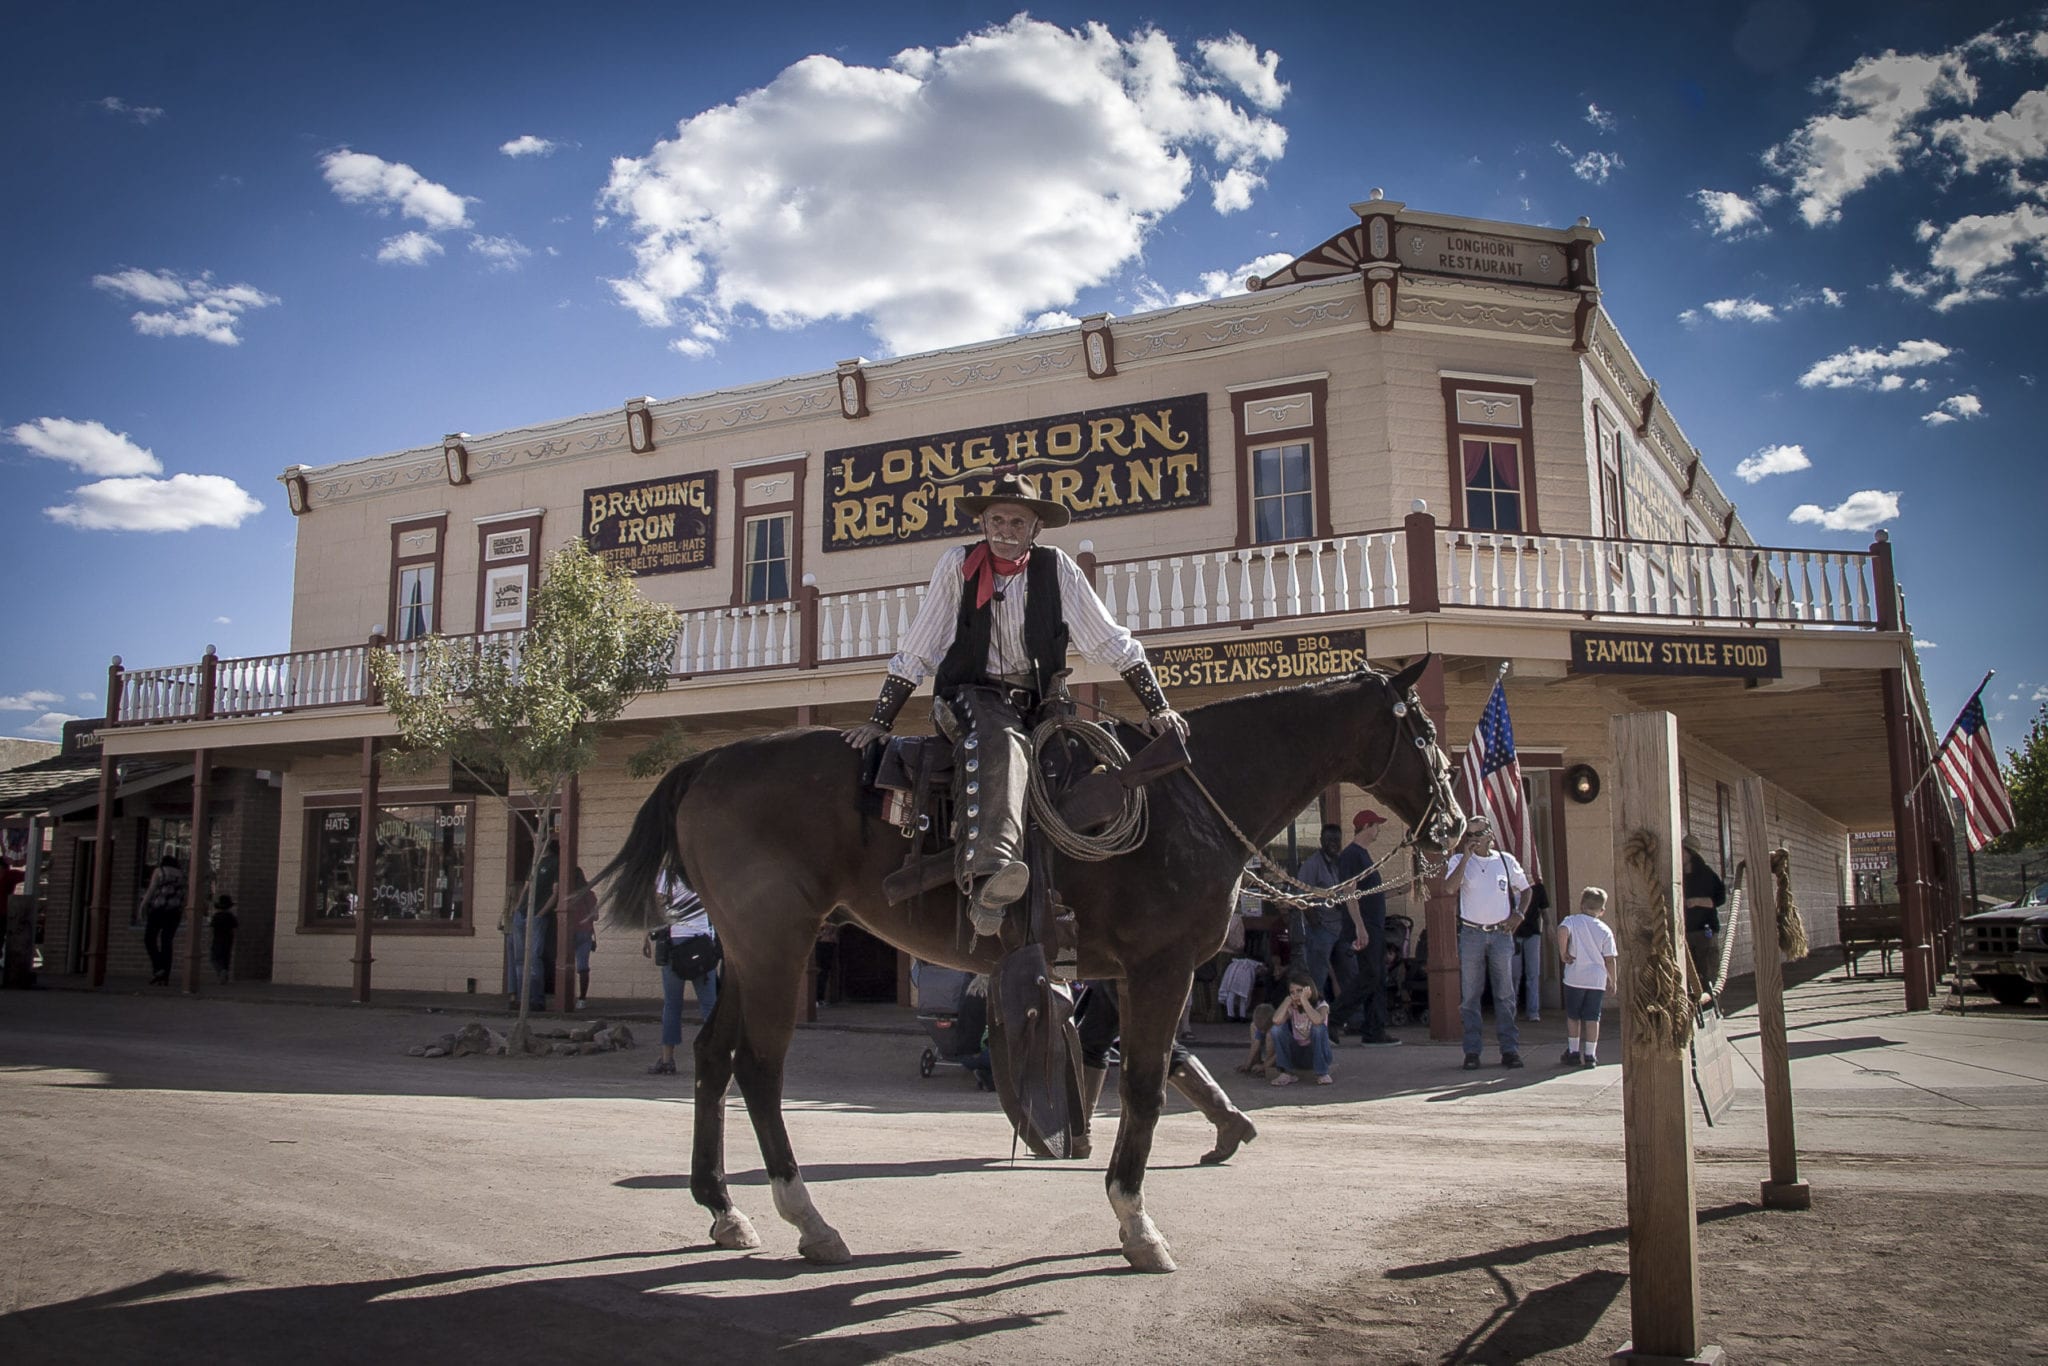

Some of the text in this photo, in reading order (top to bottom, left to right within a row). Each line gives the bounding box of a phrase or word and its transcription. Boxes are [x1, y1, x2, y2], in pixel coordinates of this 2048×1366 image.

[1447, 236, 1515, 258] LONGHORN
[1439, 253, 1524, 277] RESTAURANT
[834, 409, 1189, 496] LONGHORN
[588, 479, 712, 535] BRANDING
[832, 453, 1198, 539] RESTRANT
[618, 513, 677, 545] IRON
[640, 541, 678, 556] APPAREL
[682, 538, 706, 550] HATS
[663, 550, 705, 566] BUCKLES
[496, 597, 518, 608] OFFICE
[1163, 635, 1333, 663] AWARD WINNING BBQ
[1585, 639, 1768, 667] FAMILY STYLE FOOD
[1189, 656, 1272, 686] STEAKS
[1277, 648, 1365, 679] BURGERS
[324, 818, 350, 831] HATS
[1852, 861, 1888, 870] DAILY
